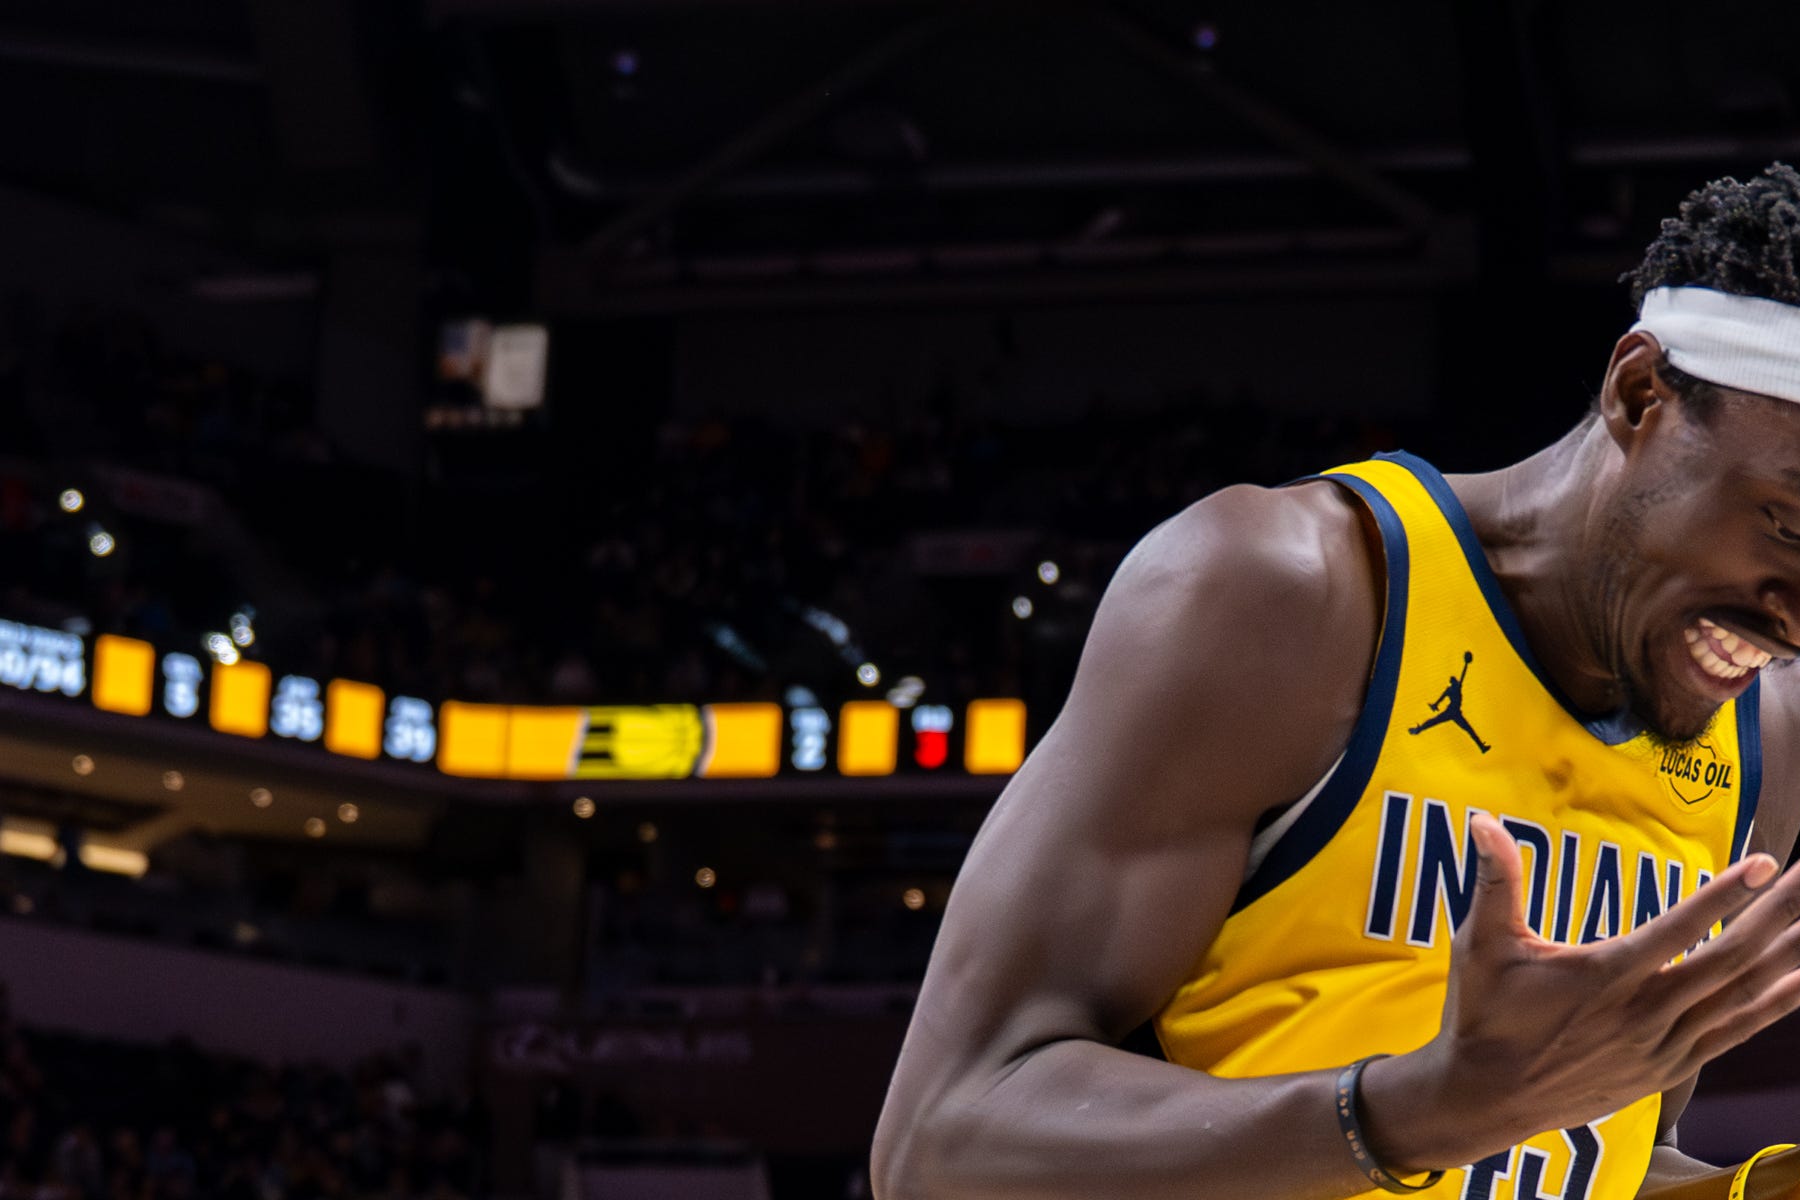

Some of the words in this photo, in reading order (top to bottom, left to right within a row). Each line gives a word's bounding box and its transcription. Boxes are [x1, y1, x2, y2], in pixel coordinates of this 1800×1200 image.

[1660, 748, 1702, 783] LUCAS
[1704, 762, 1732, 790] OIL
[1364, 790, 1717, 957] INDIAN
